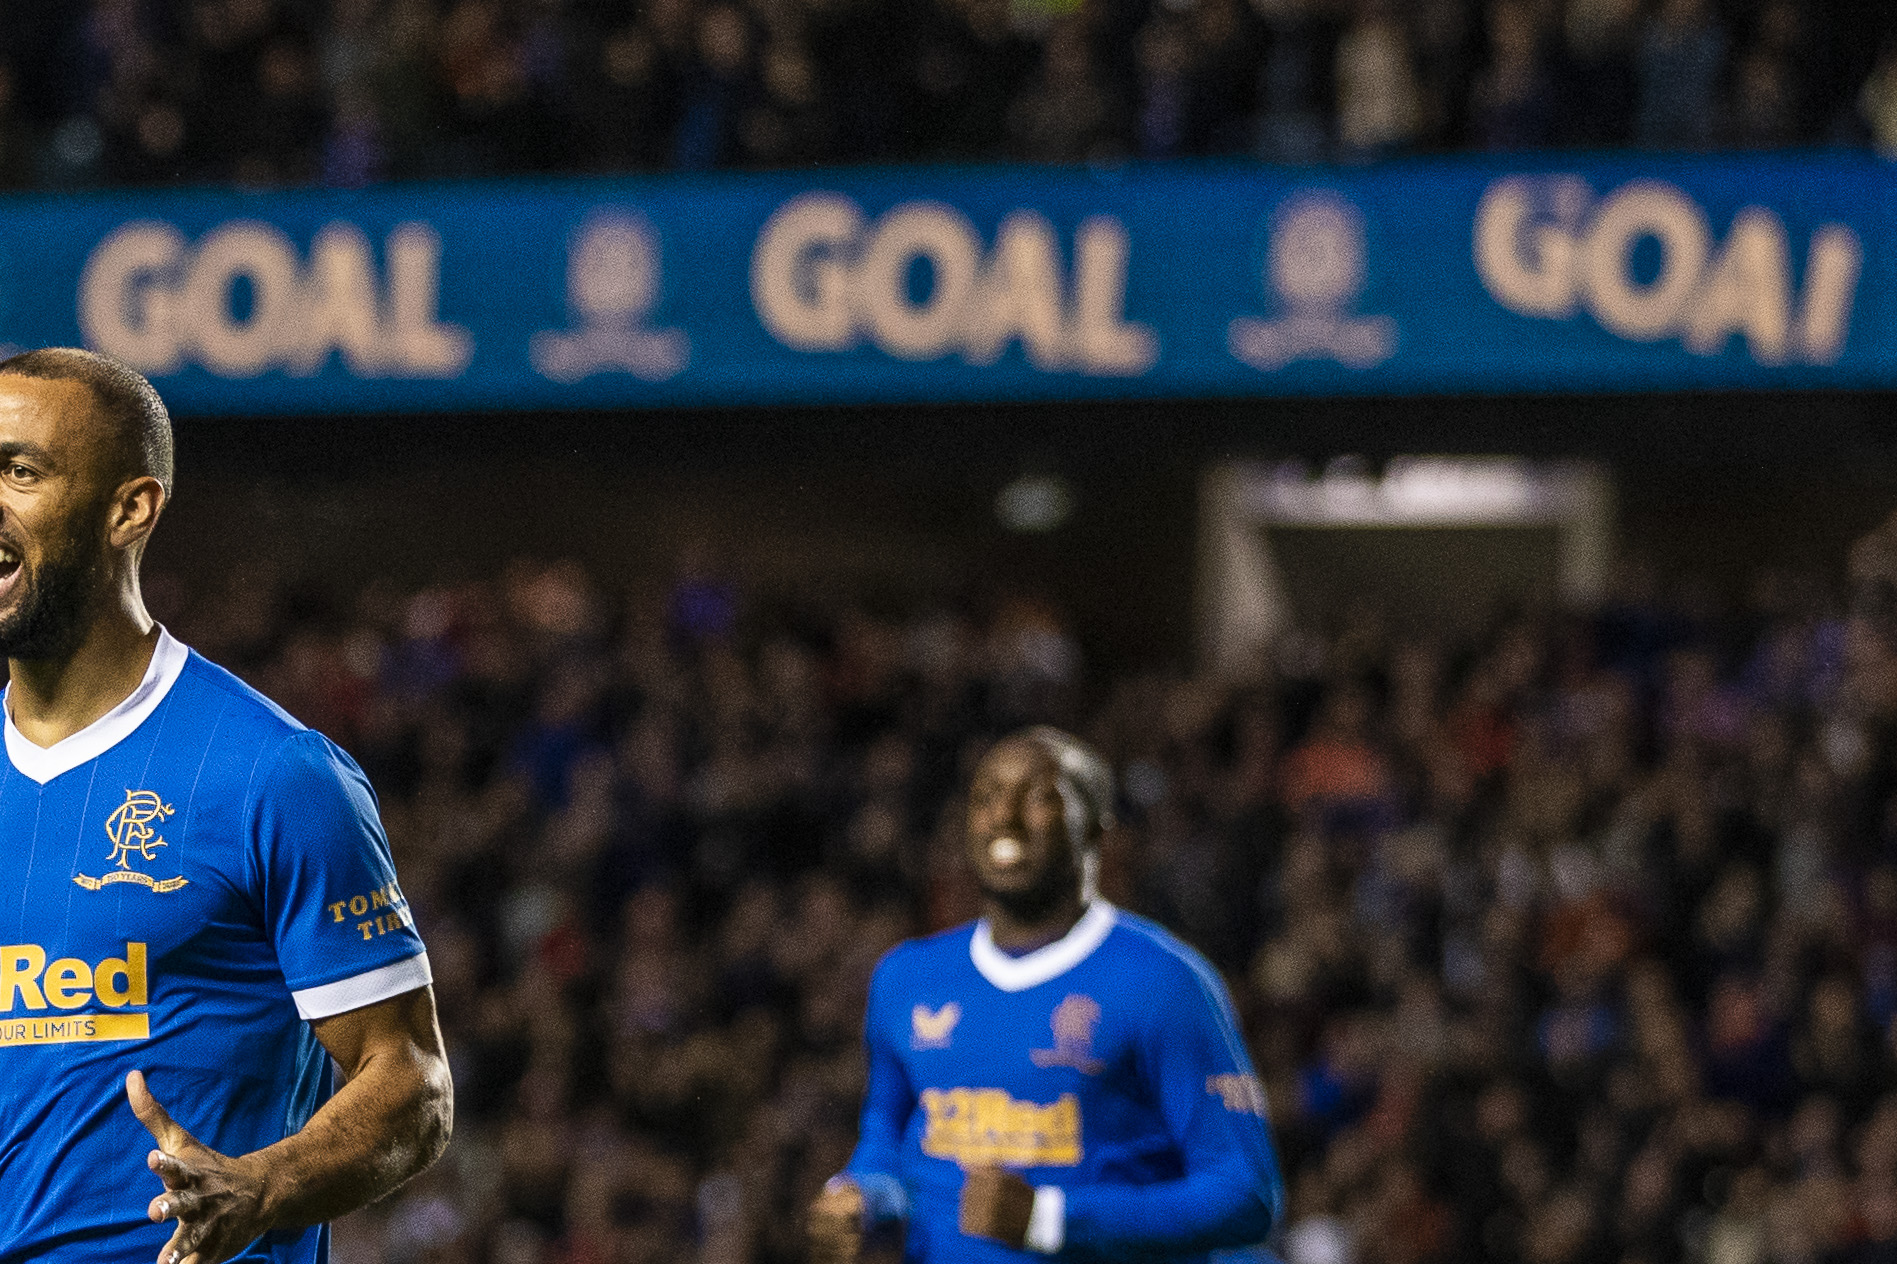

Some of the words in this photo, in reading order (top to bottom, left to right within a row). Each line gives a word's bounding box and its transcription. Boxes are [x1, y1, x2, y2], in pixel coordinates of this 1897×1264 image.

[78, 219, 473, 379] GOAL
[750, 191, 1158, 376] GOAL
[33, 1020, 96, 1039] LIMITS
